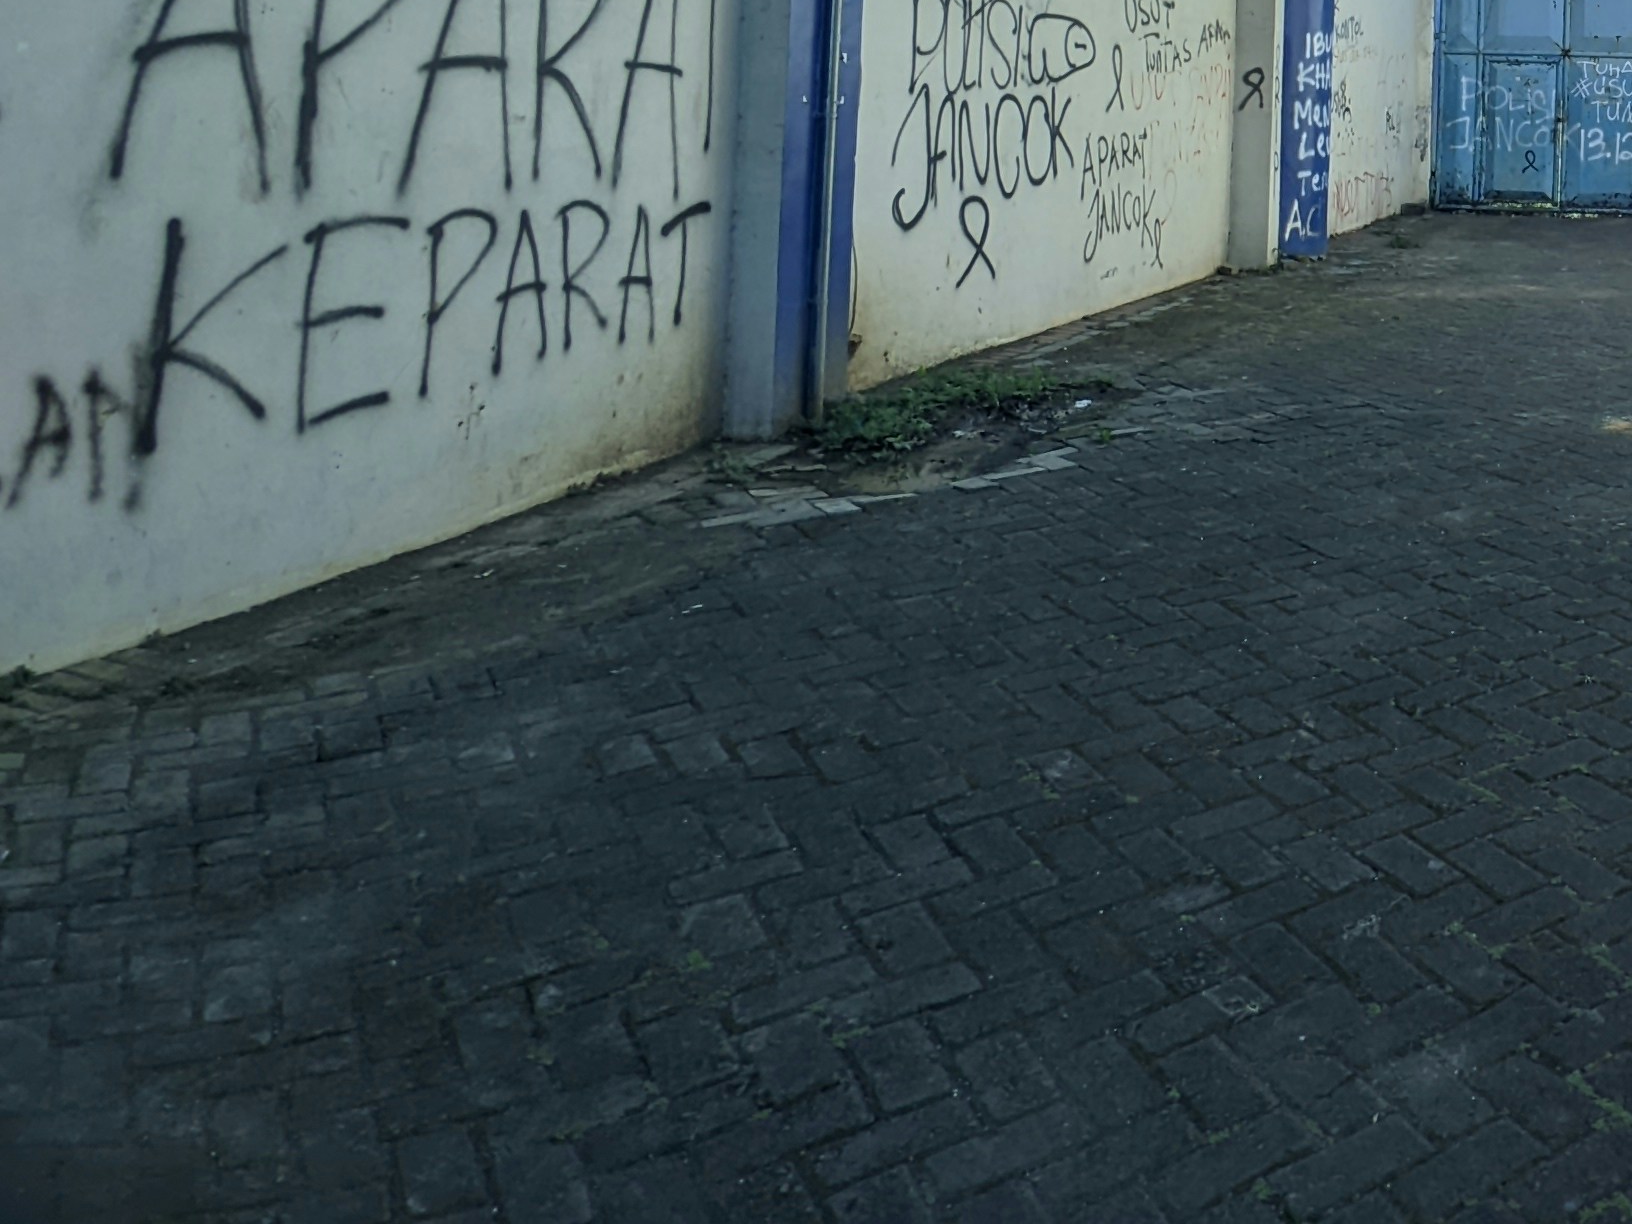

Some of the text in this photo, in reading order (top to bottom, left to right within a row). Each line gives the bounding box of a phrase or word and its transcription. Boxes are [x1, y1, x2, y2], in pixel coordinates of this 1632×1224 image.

[1305, 31, 1332, 59] IBU
[1460, 75, 1557, 125] POLISI
[889, 82, 1075, 231] JANCOK
[1080, 127, 1148, 201] APARAT
[1083, 182, 1157, 263] JANCOK
[130, 198, 712, 458] KEPARAT
